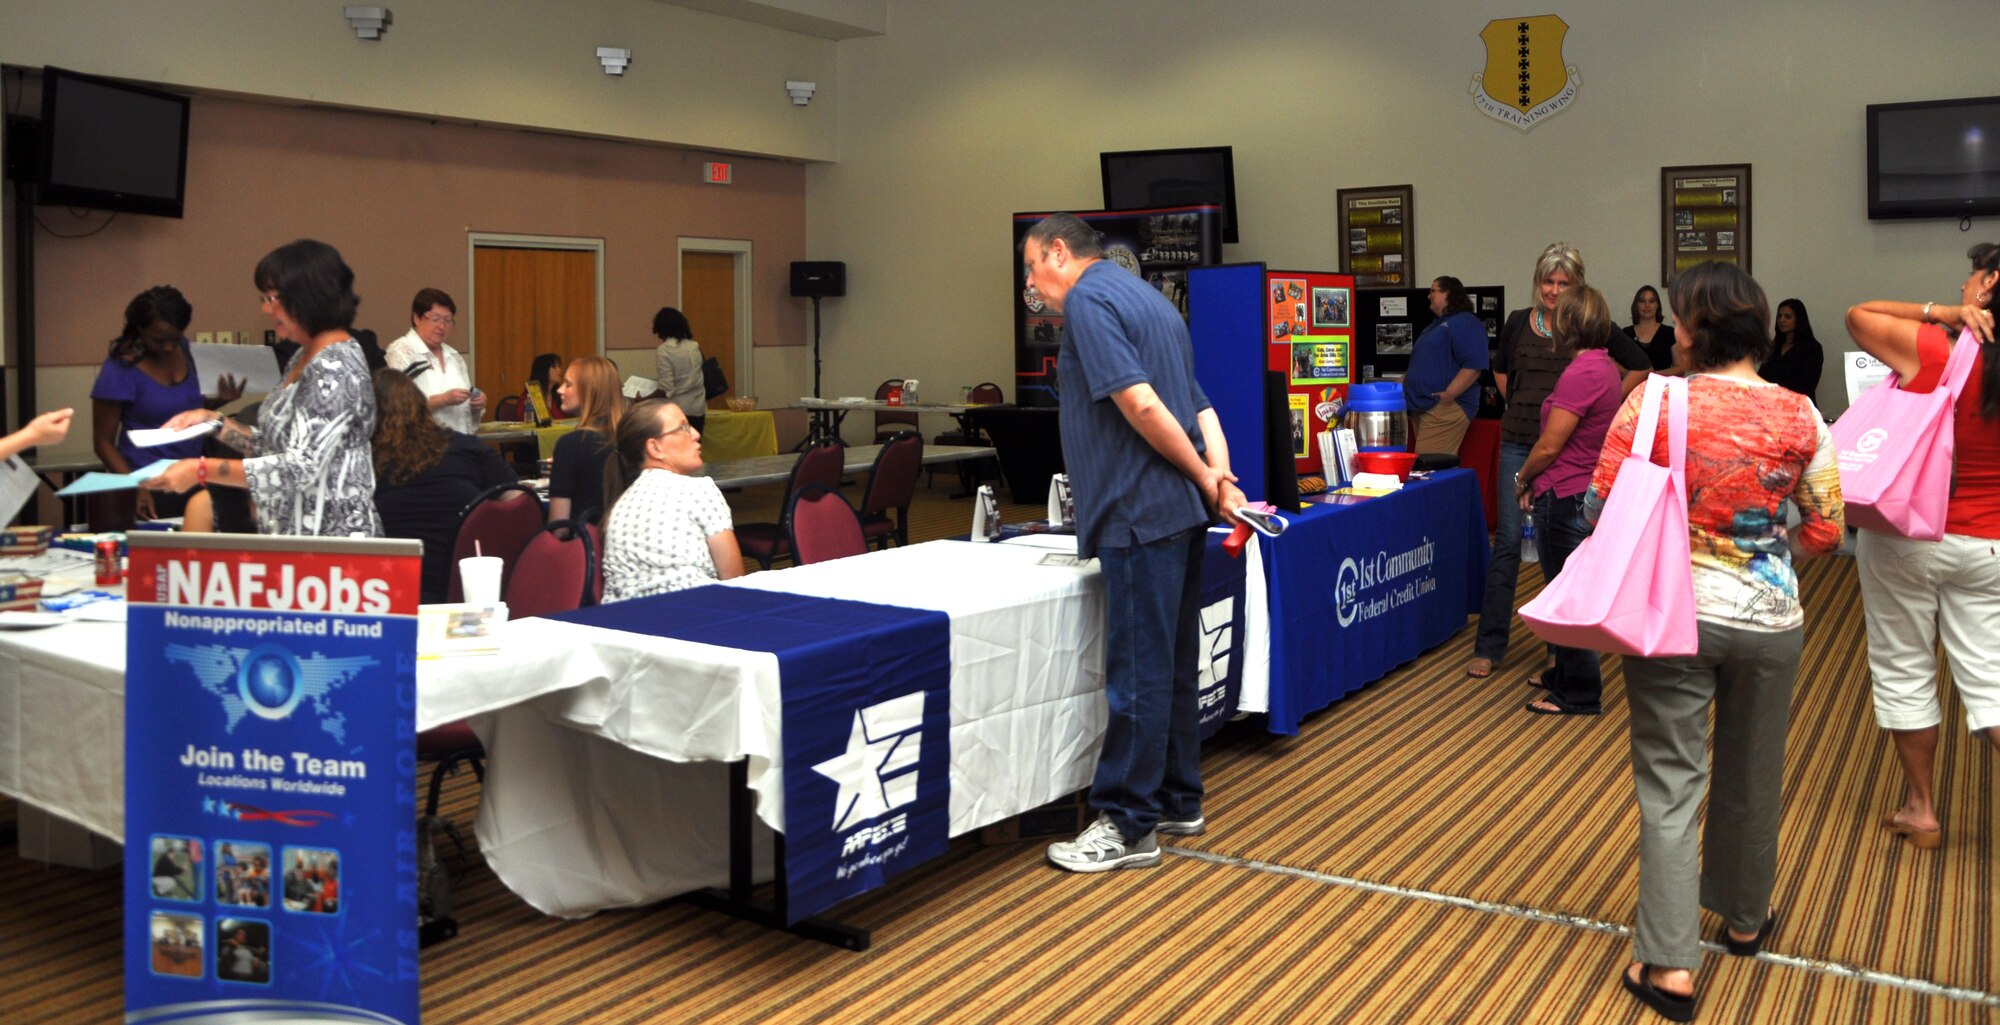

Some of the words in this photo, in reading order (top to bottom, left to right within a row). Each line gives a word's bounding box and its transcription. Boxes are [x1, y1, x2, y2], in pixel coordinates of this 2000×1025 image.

[1475, 93, 1494, 112] 17TH
[1498, 106, 1549, 125] TRAINING
[1550, 87, 1575, 110] WING
[711, 162, 729, 181] EXIT
[1359, 557, 1375, 591] 1st
[1376, 536, 1435, 584] Community
[167, 560, 392, 615] NAFJobs
[1358, 592, 1389, 623] Federal
[1390, 582, 1415, 609] Credit
[1415, 575, 1436, 597] Union
[164, 611, 327, 635] Nonappropriated
[333, 619, 383, 638] Fund
[180, 744, 235, 769] Join
[242, 749, 285, 773] the
[291, 752, 367, 779] Team
[198, 772, 268, 790] Locations
[271, 777, 346, 796] Worldwide
